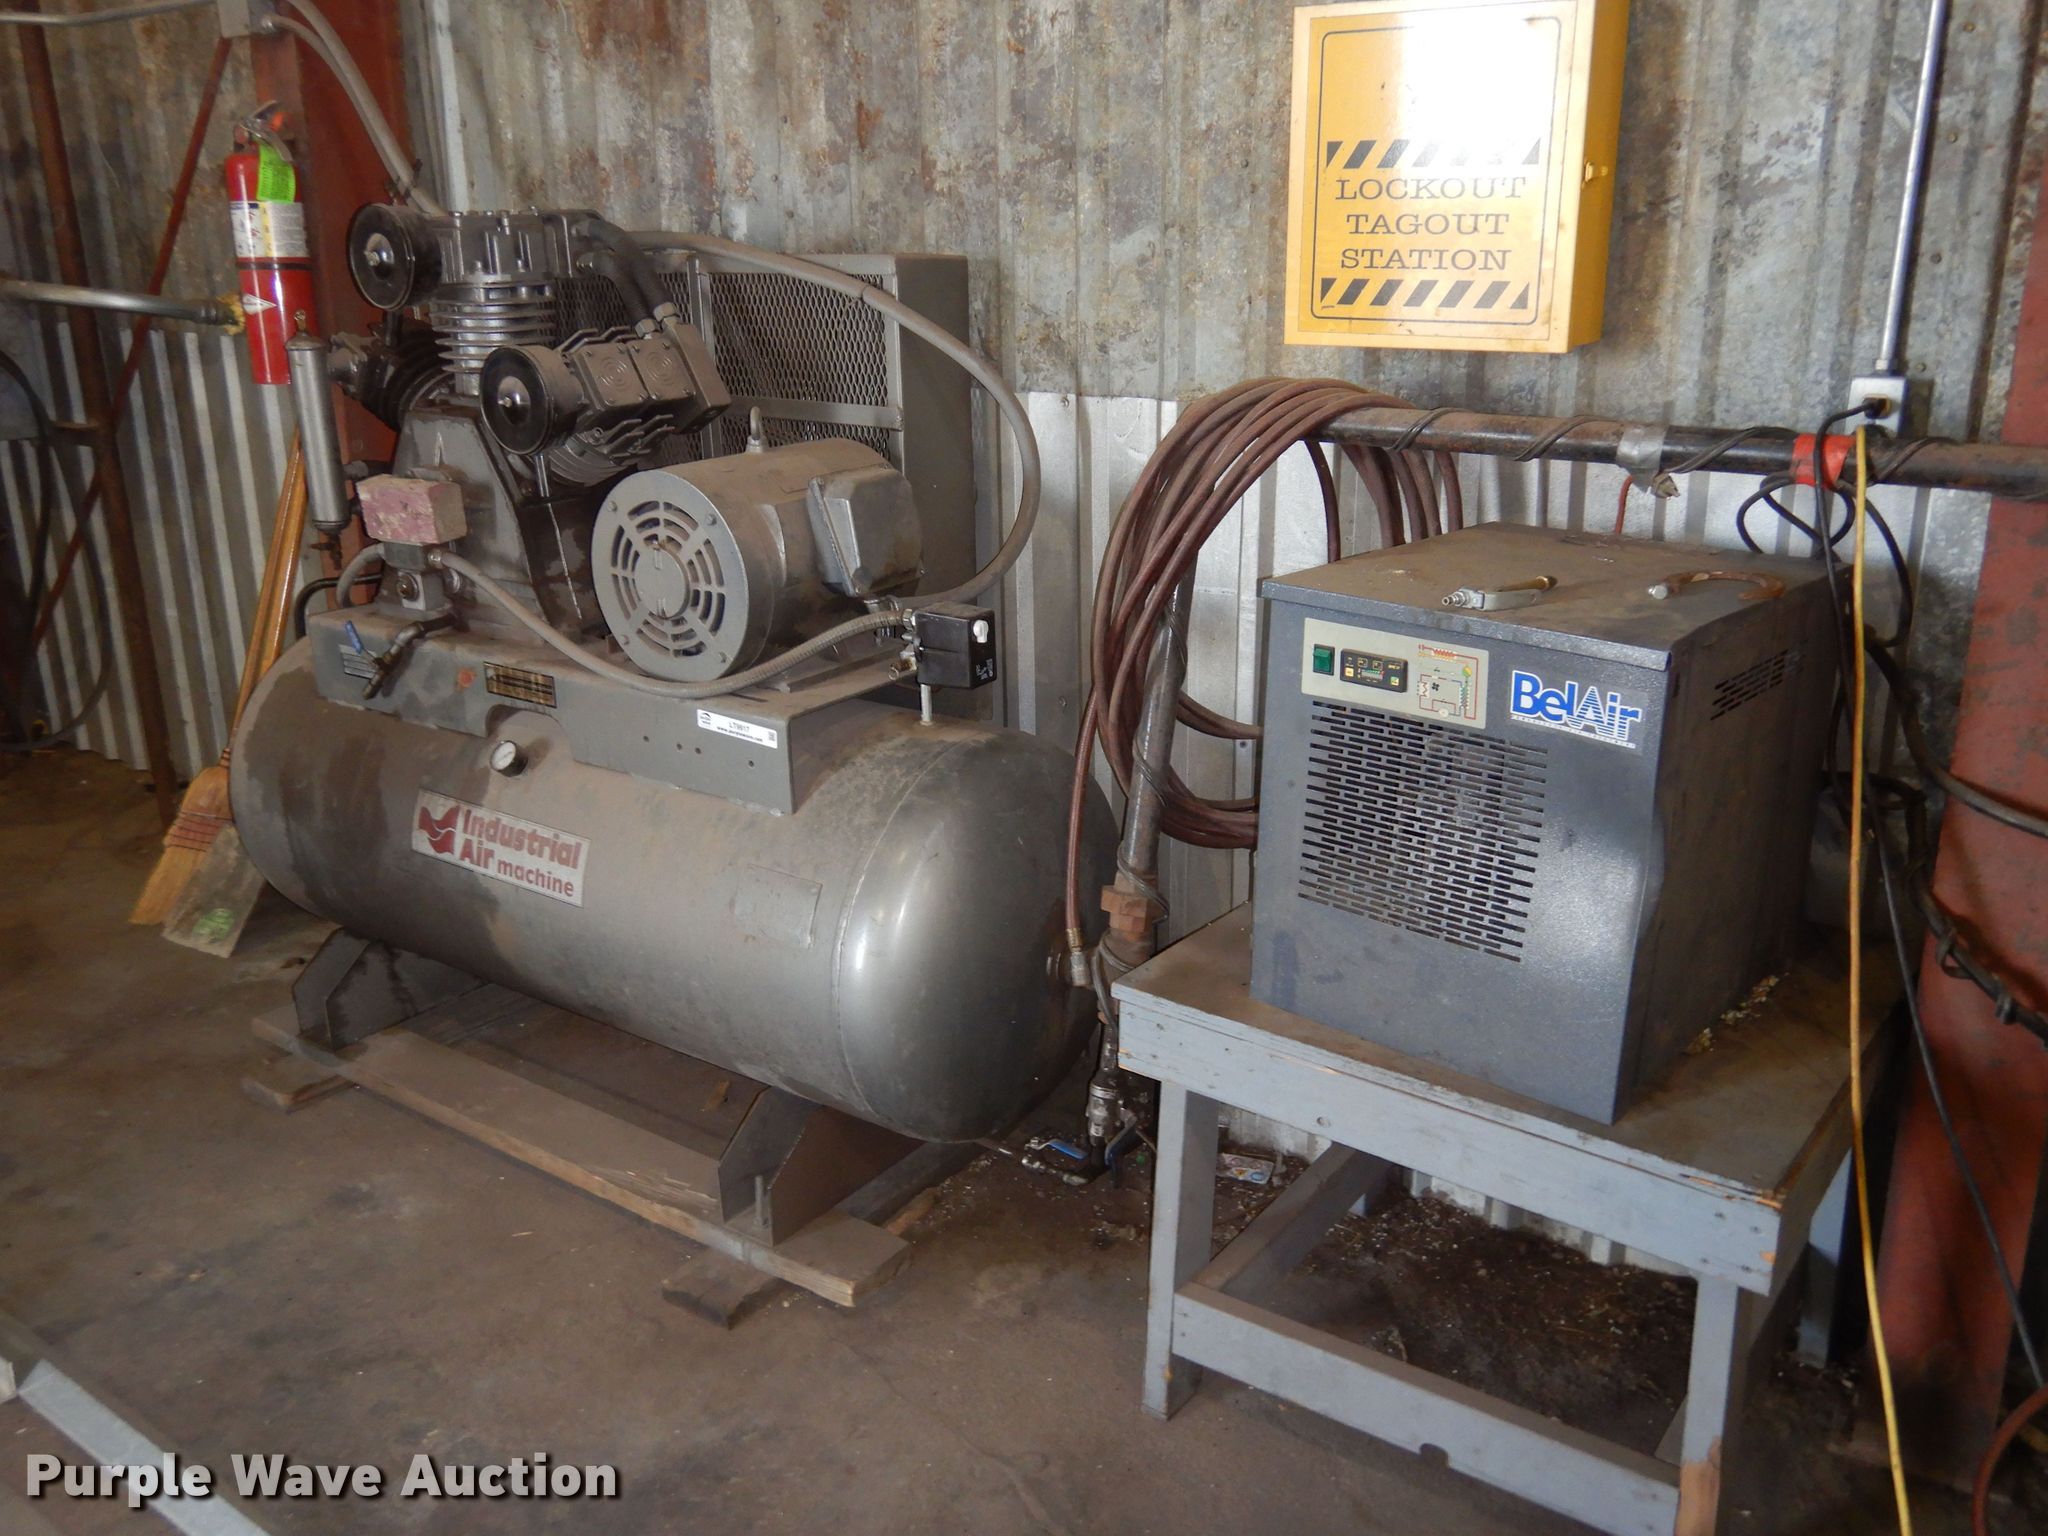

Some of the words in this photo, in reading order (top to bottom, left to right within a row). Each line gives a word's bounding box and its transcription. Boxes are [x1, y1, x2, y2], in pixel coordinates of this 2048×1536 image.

[1335, 177, 1526, 200] LOCKOUT
[1346, 213, 1510, 235] TAGOUT
[1341, 248, 1512, 271] STATION
[1510, 669, 1643, 742] BelAir
[462, 809, 583, 869] Industrial
[459, 838, 495, 869] Air
[497, 858, 574, 897] machine
